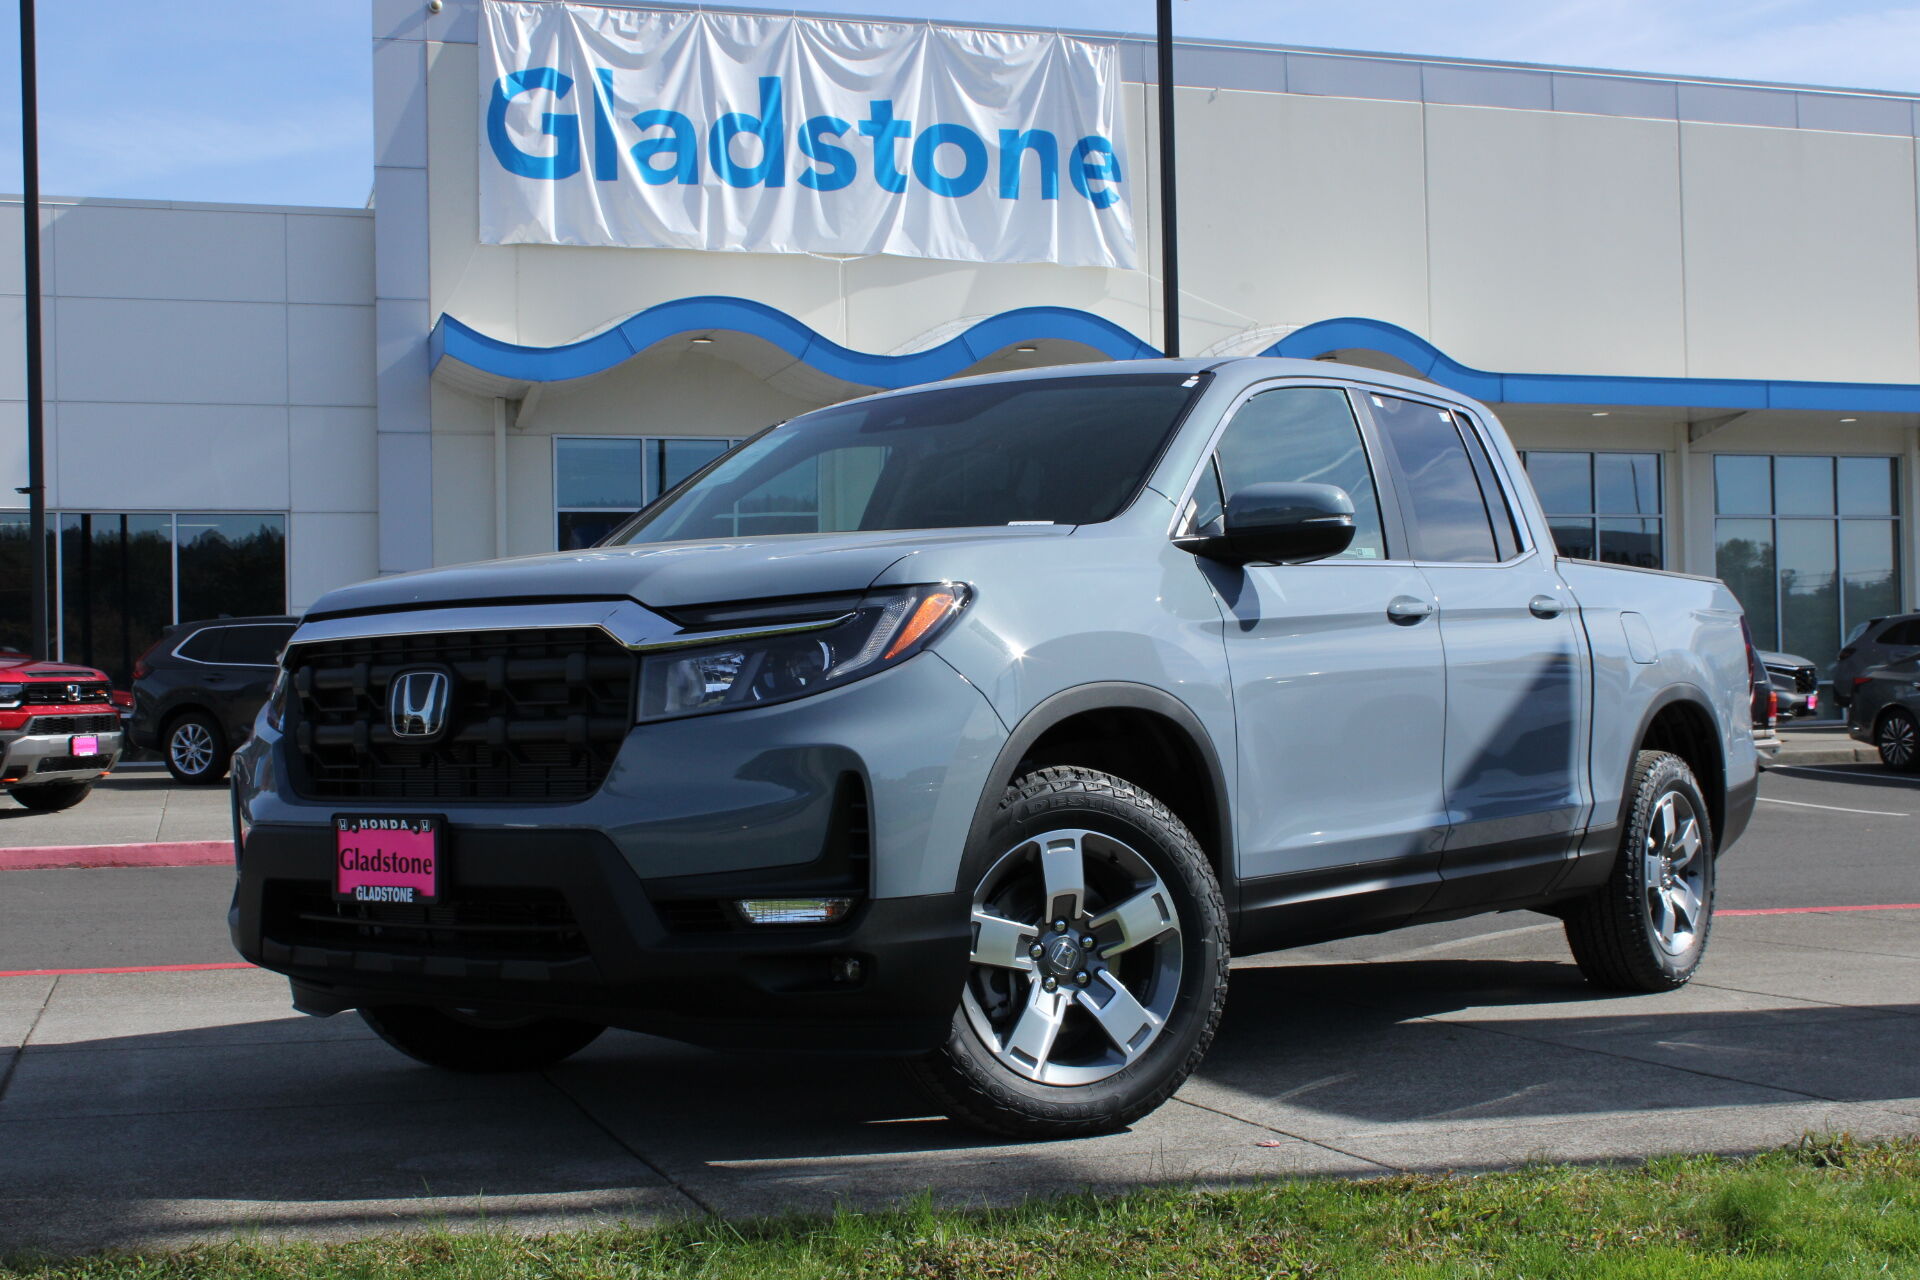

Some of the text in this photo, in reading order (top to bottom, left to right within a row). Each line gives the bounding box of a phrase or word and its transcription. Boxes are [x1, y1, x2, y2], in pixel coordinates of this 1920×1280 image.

[487, 67, 1122, 209] Gladstone
[360, 819, 409, 830] HONDA
[340, 847, 433, 875] Gladstone
[356, 886, 413, 903] GLADSTONE
